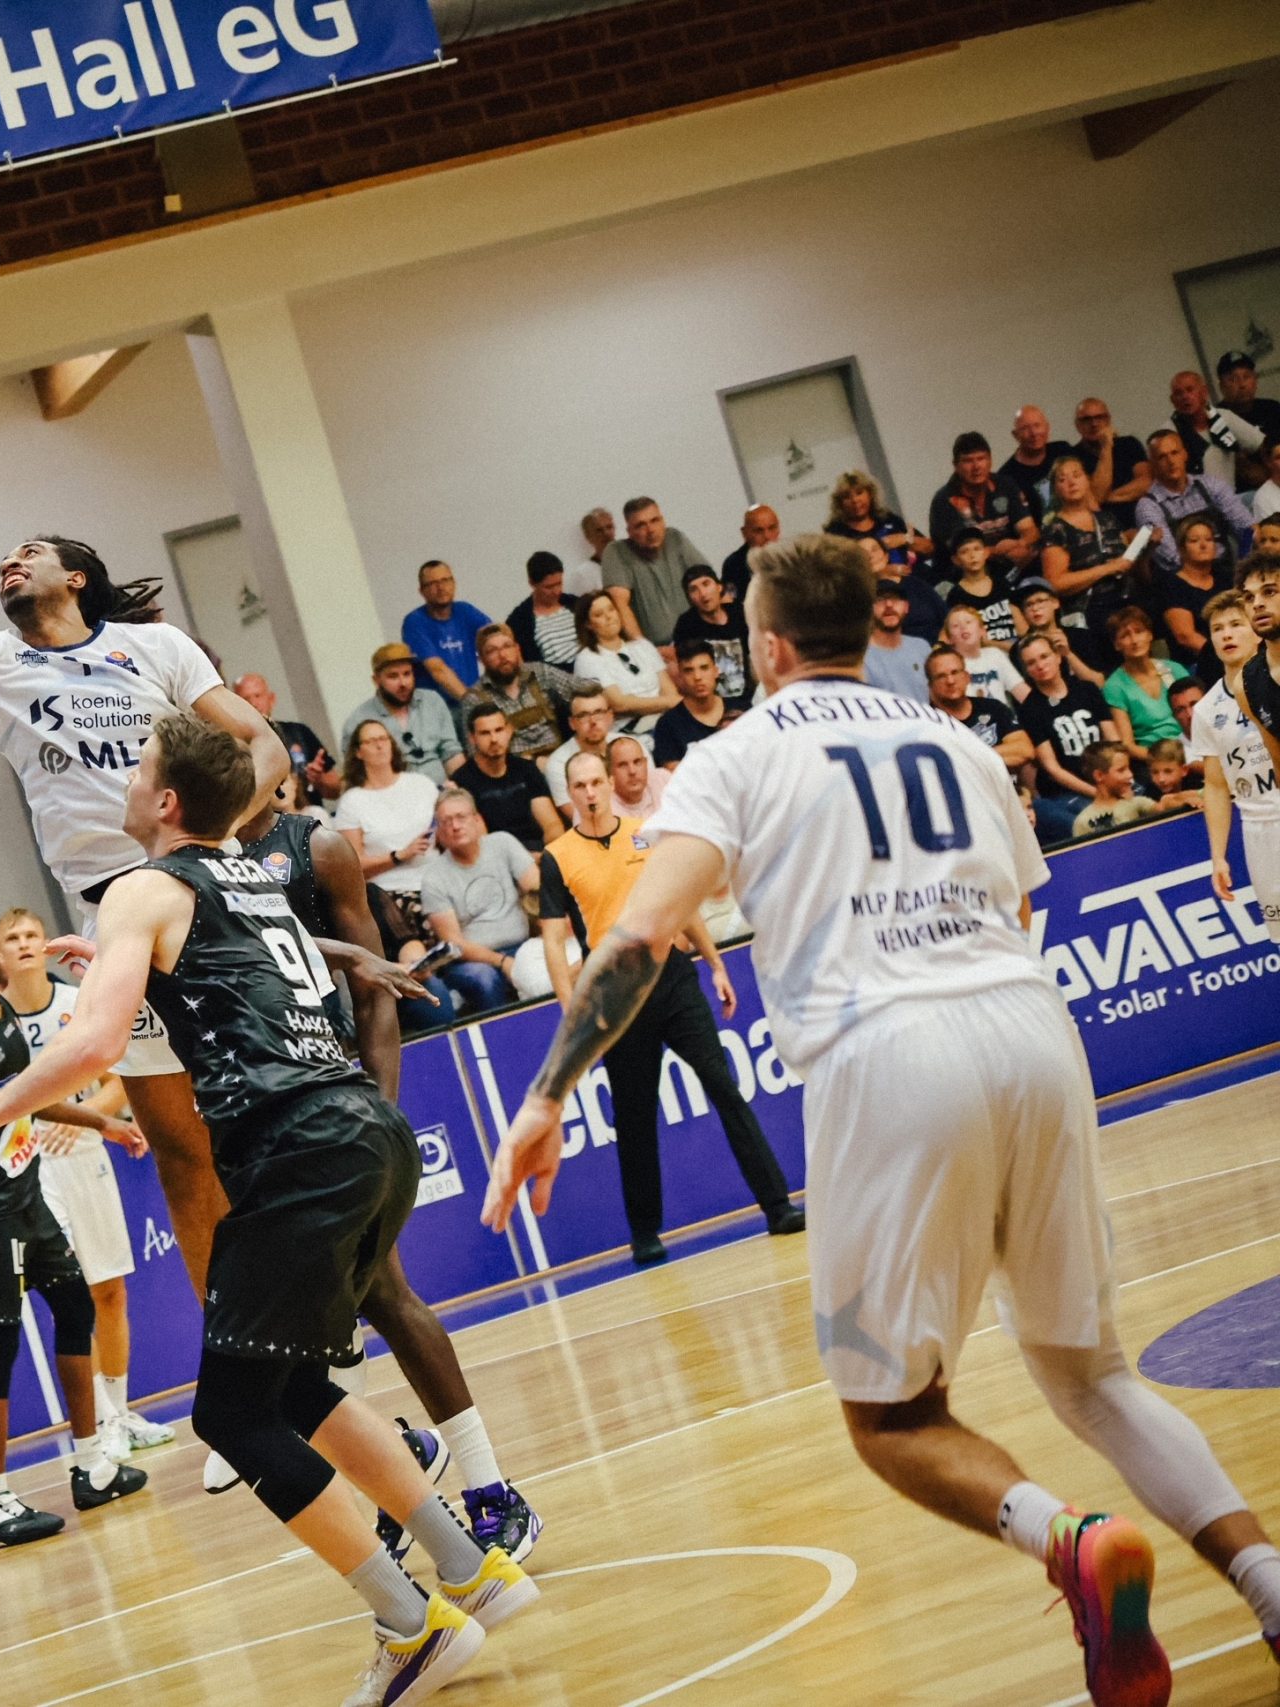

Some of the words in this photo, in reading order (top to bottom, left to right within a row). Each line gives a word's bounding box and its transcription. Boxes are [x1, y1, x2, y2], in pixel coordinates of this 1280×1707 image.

[217, 0, 359, 75] eG
[71, 694, 131, 710] koenig
[73, 712, 152, 729] solutions
[78, 737, 148, 770] ML
[824, 742, 974, 861] 10
[1099, 988, 1167, 1024] Solar
[28, 1023, 43, 1048] 2
